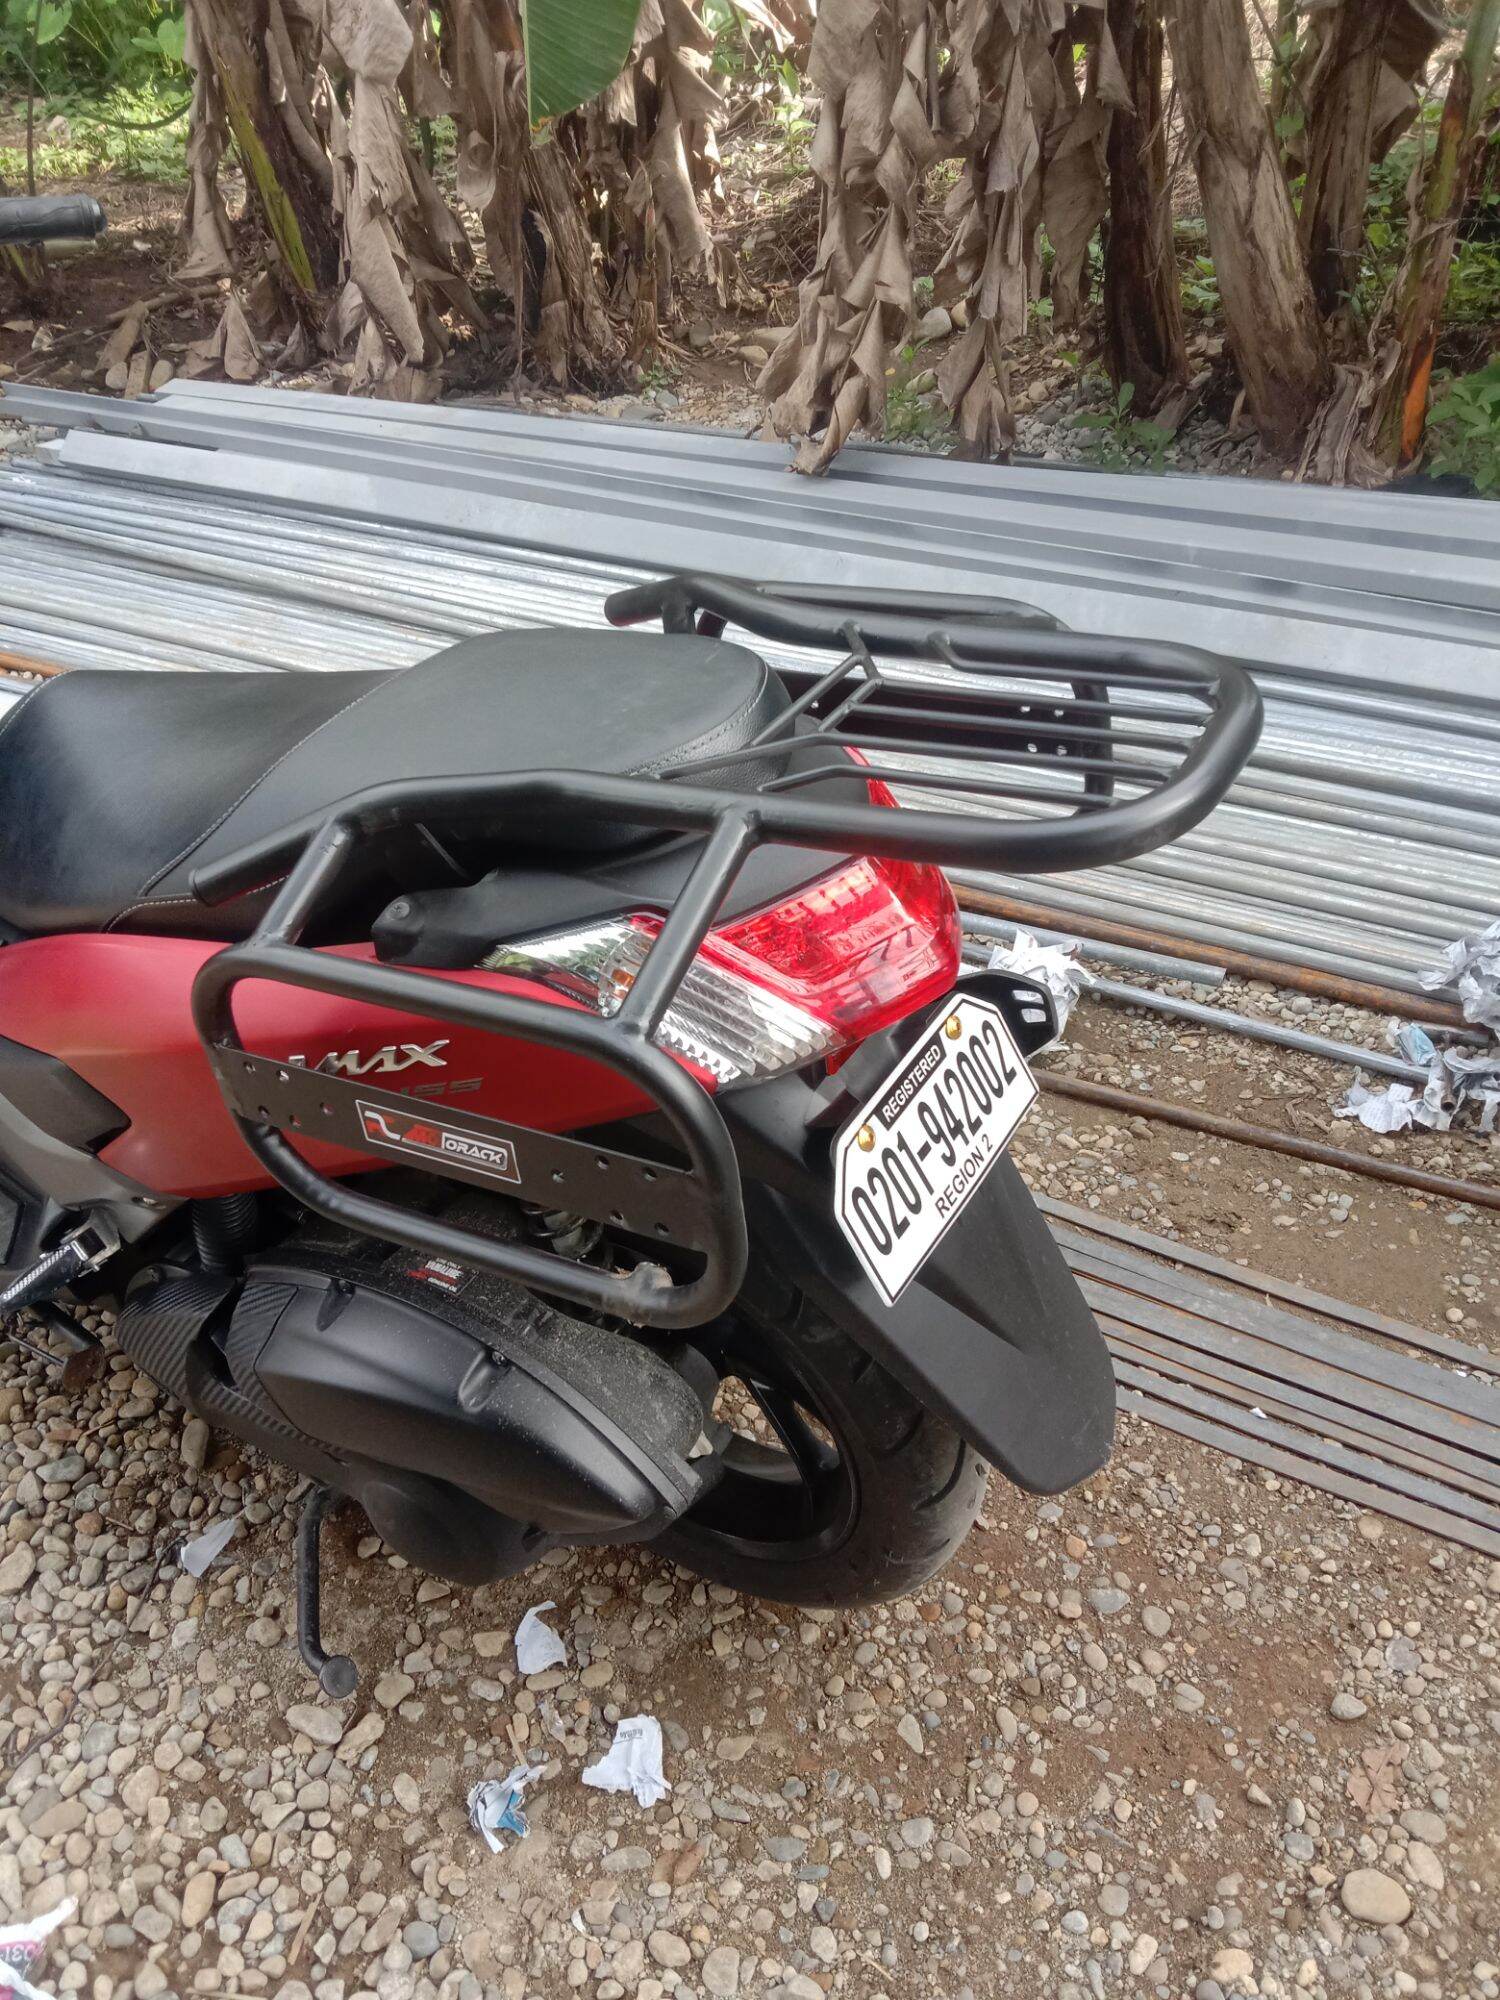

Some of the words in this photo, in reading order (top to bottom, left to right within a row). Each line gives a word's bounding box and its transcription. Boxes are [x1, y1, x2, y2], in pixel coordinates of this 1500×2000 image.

[882, 1045, 941, 1122] REGISTERED
[851, 1019, 1018, 1256] 0201-942002
[935, 1147, 984, 1218] REGION
[982, 1133, 994, 1152] 2
